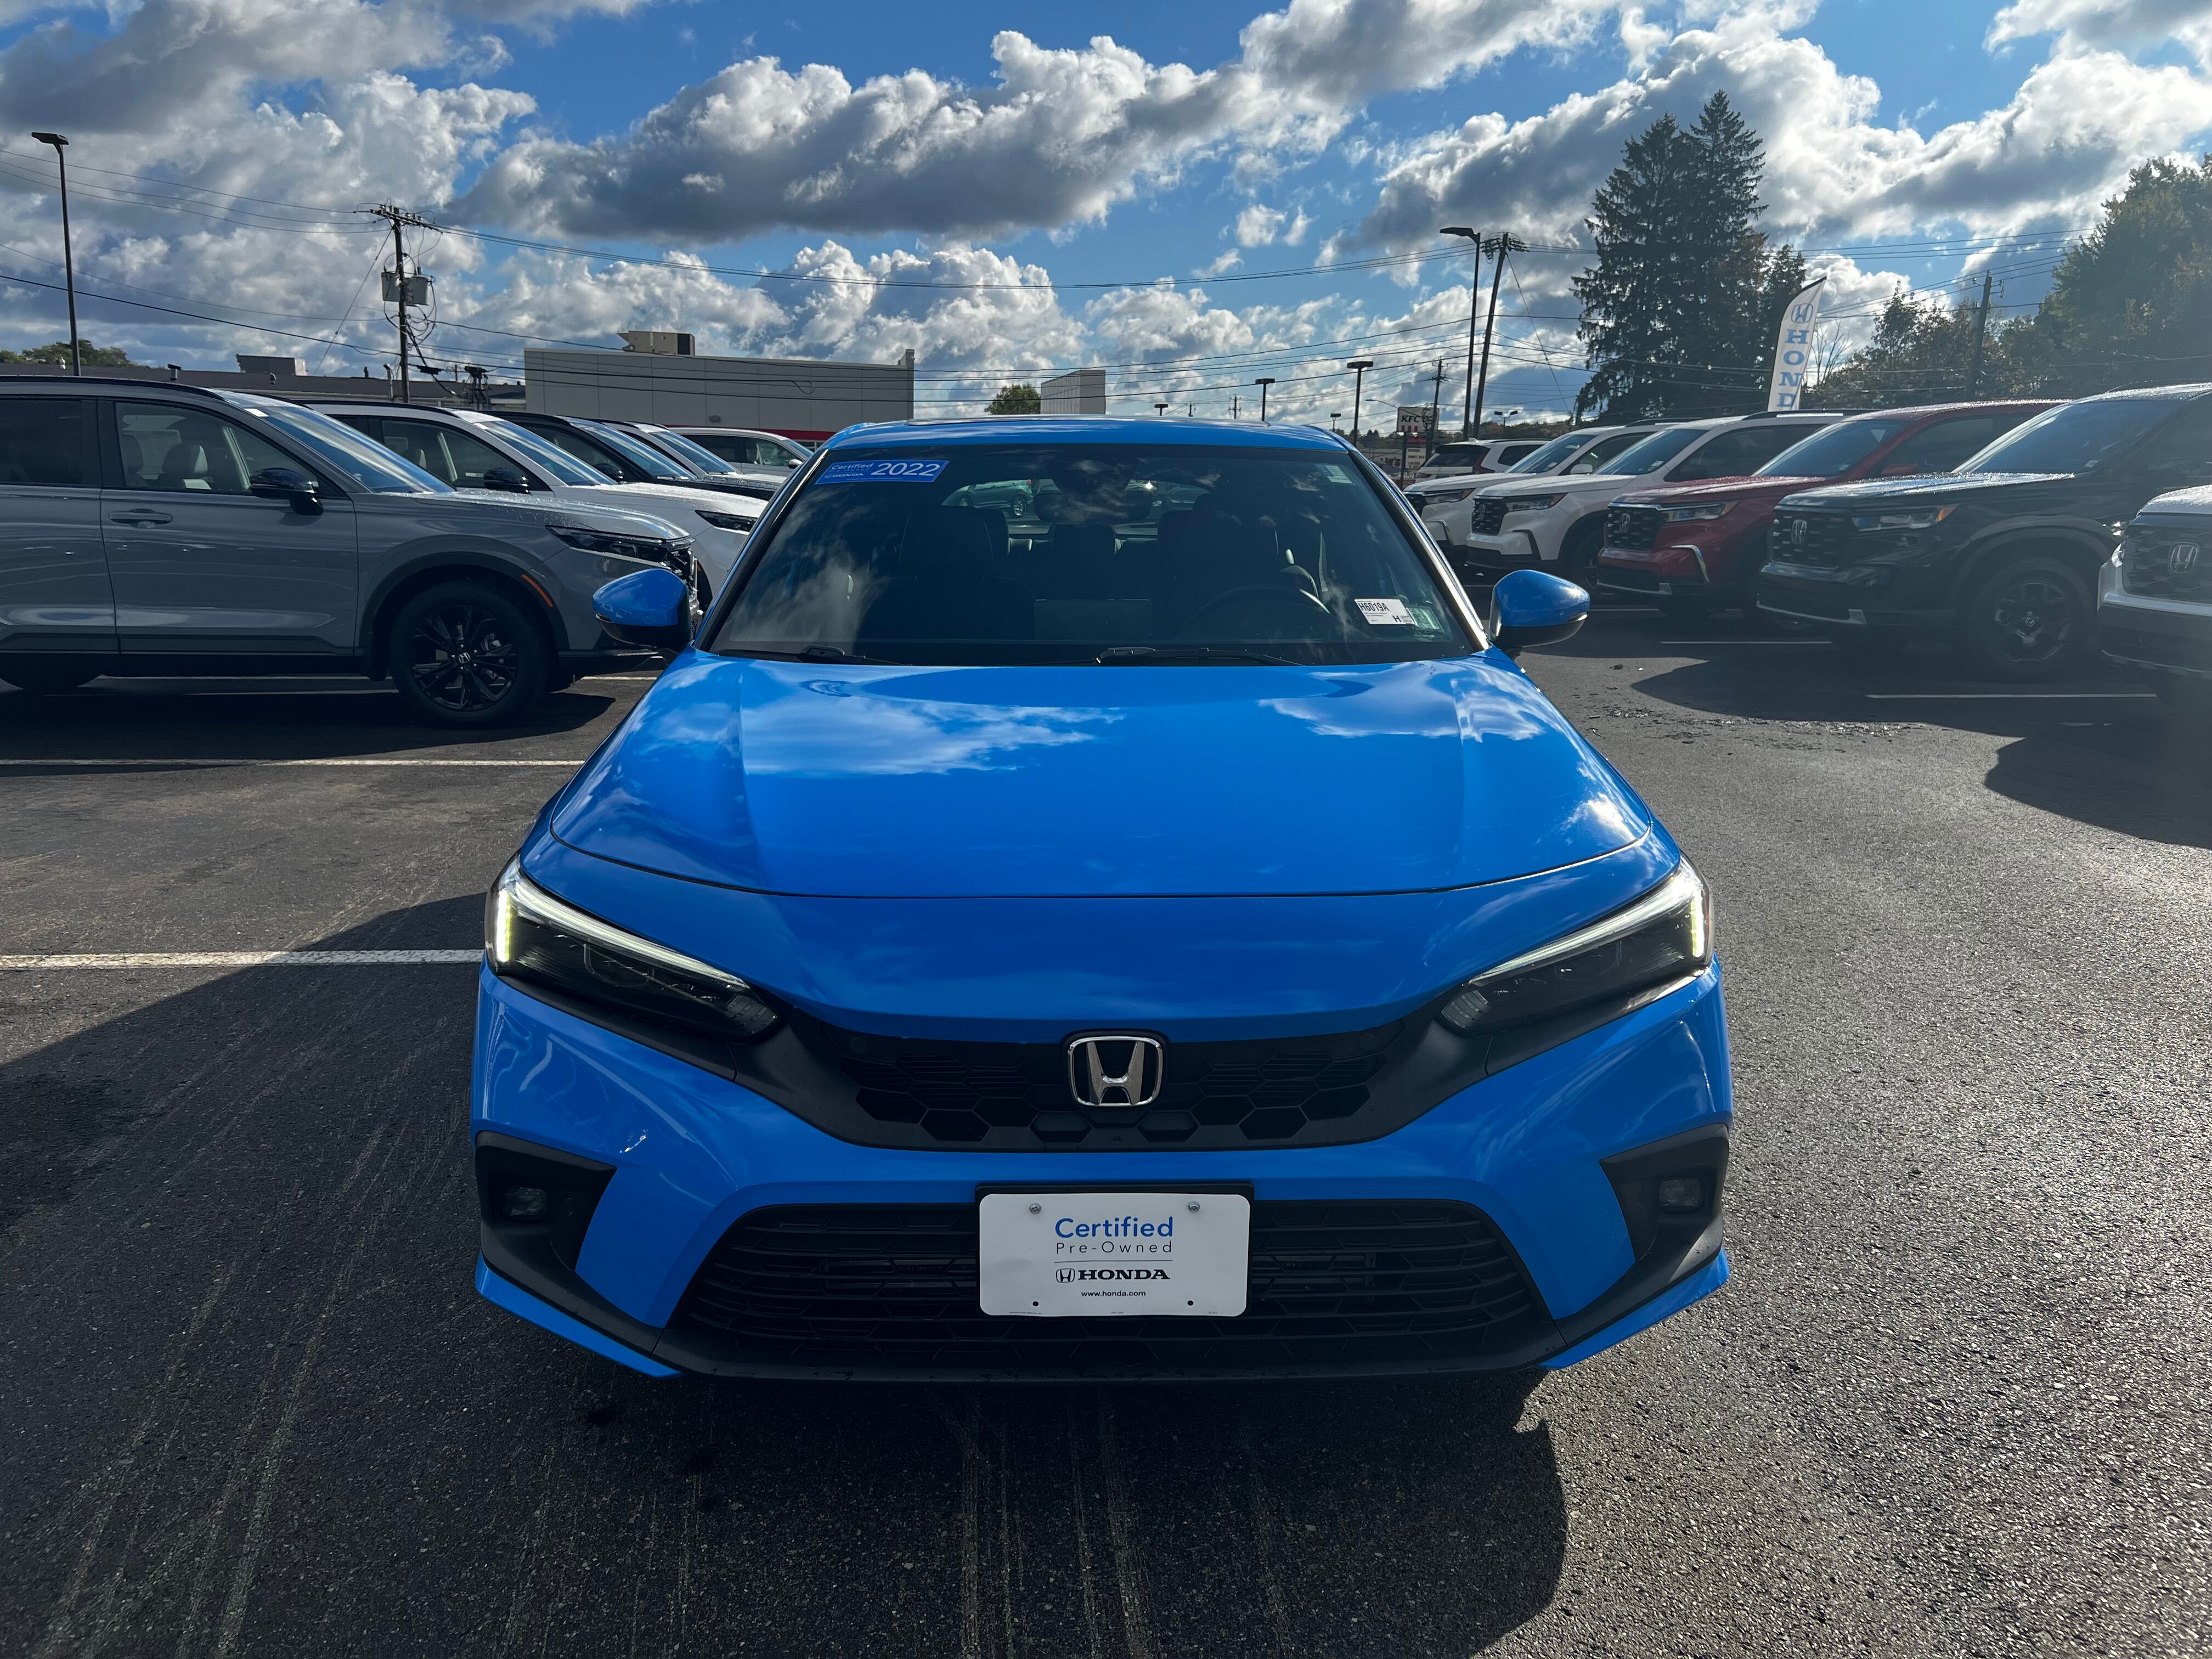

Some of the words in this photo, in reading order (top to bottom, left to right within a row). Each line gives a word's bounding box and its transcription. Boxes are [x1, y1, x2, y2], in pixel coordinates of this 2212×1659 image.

[871, 463, 940, 476] 2022
[1358, 602, 1390, 612] H6019A
[1055, 1216, 1173, 1238] Certified
[1056, 1241, 1172, 1254] Pre-Owned
[1077, 1269, 1171, 1280] HONDA
[1081, 1290, 1146, 1298] www.honda.com
